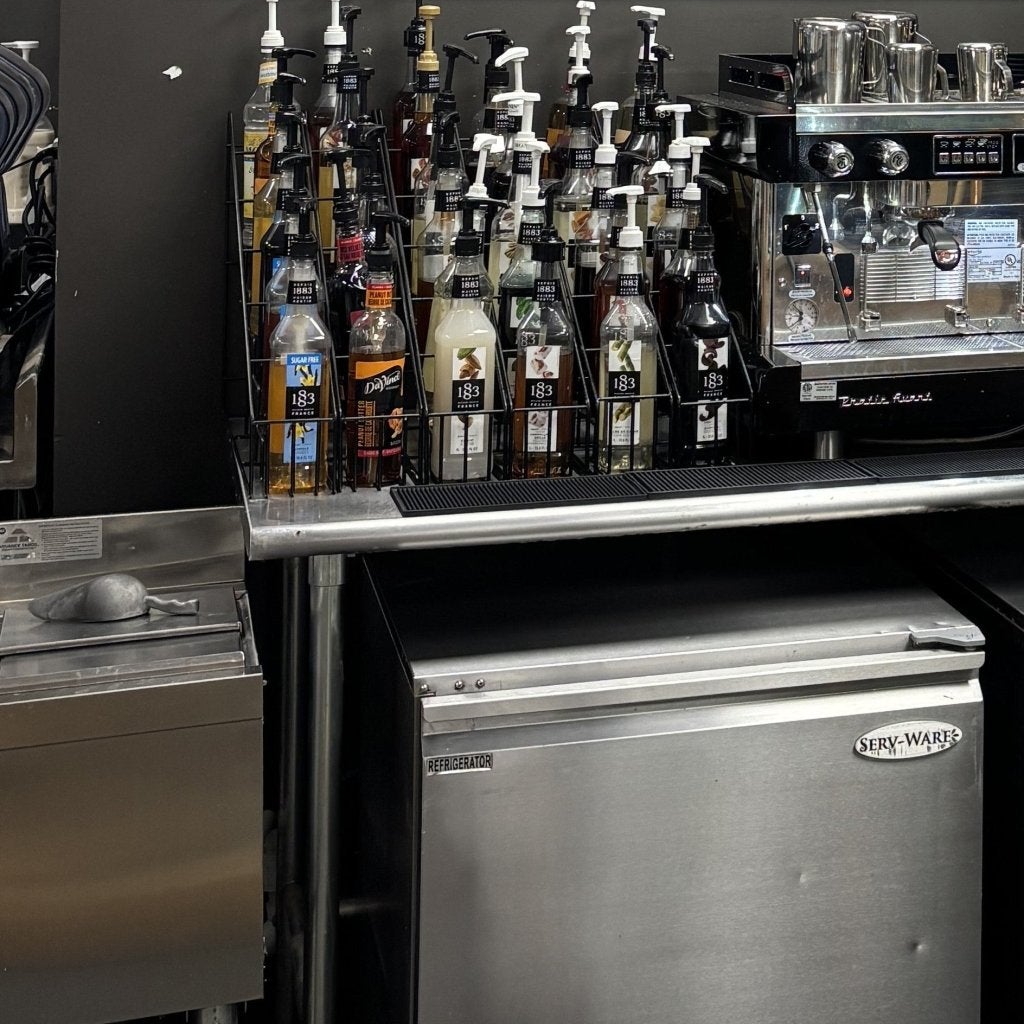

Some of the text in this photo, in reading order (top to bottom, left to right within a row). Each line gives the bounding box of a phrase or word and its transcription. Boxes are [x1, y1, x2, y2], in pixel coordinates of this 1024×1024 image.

[290, 355, 320, 364] SUGAR FREE
[859, 730, 951, 752] SERV-WARE
[428, 754, 491, 772] REFRIGERATOR
